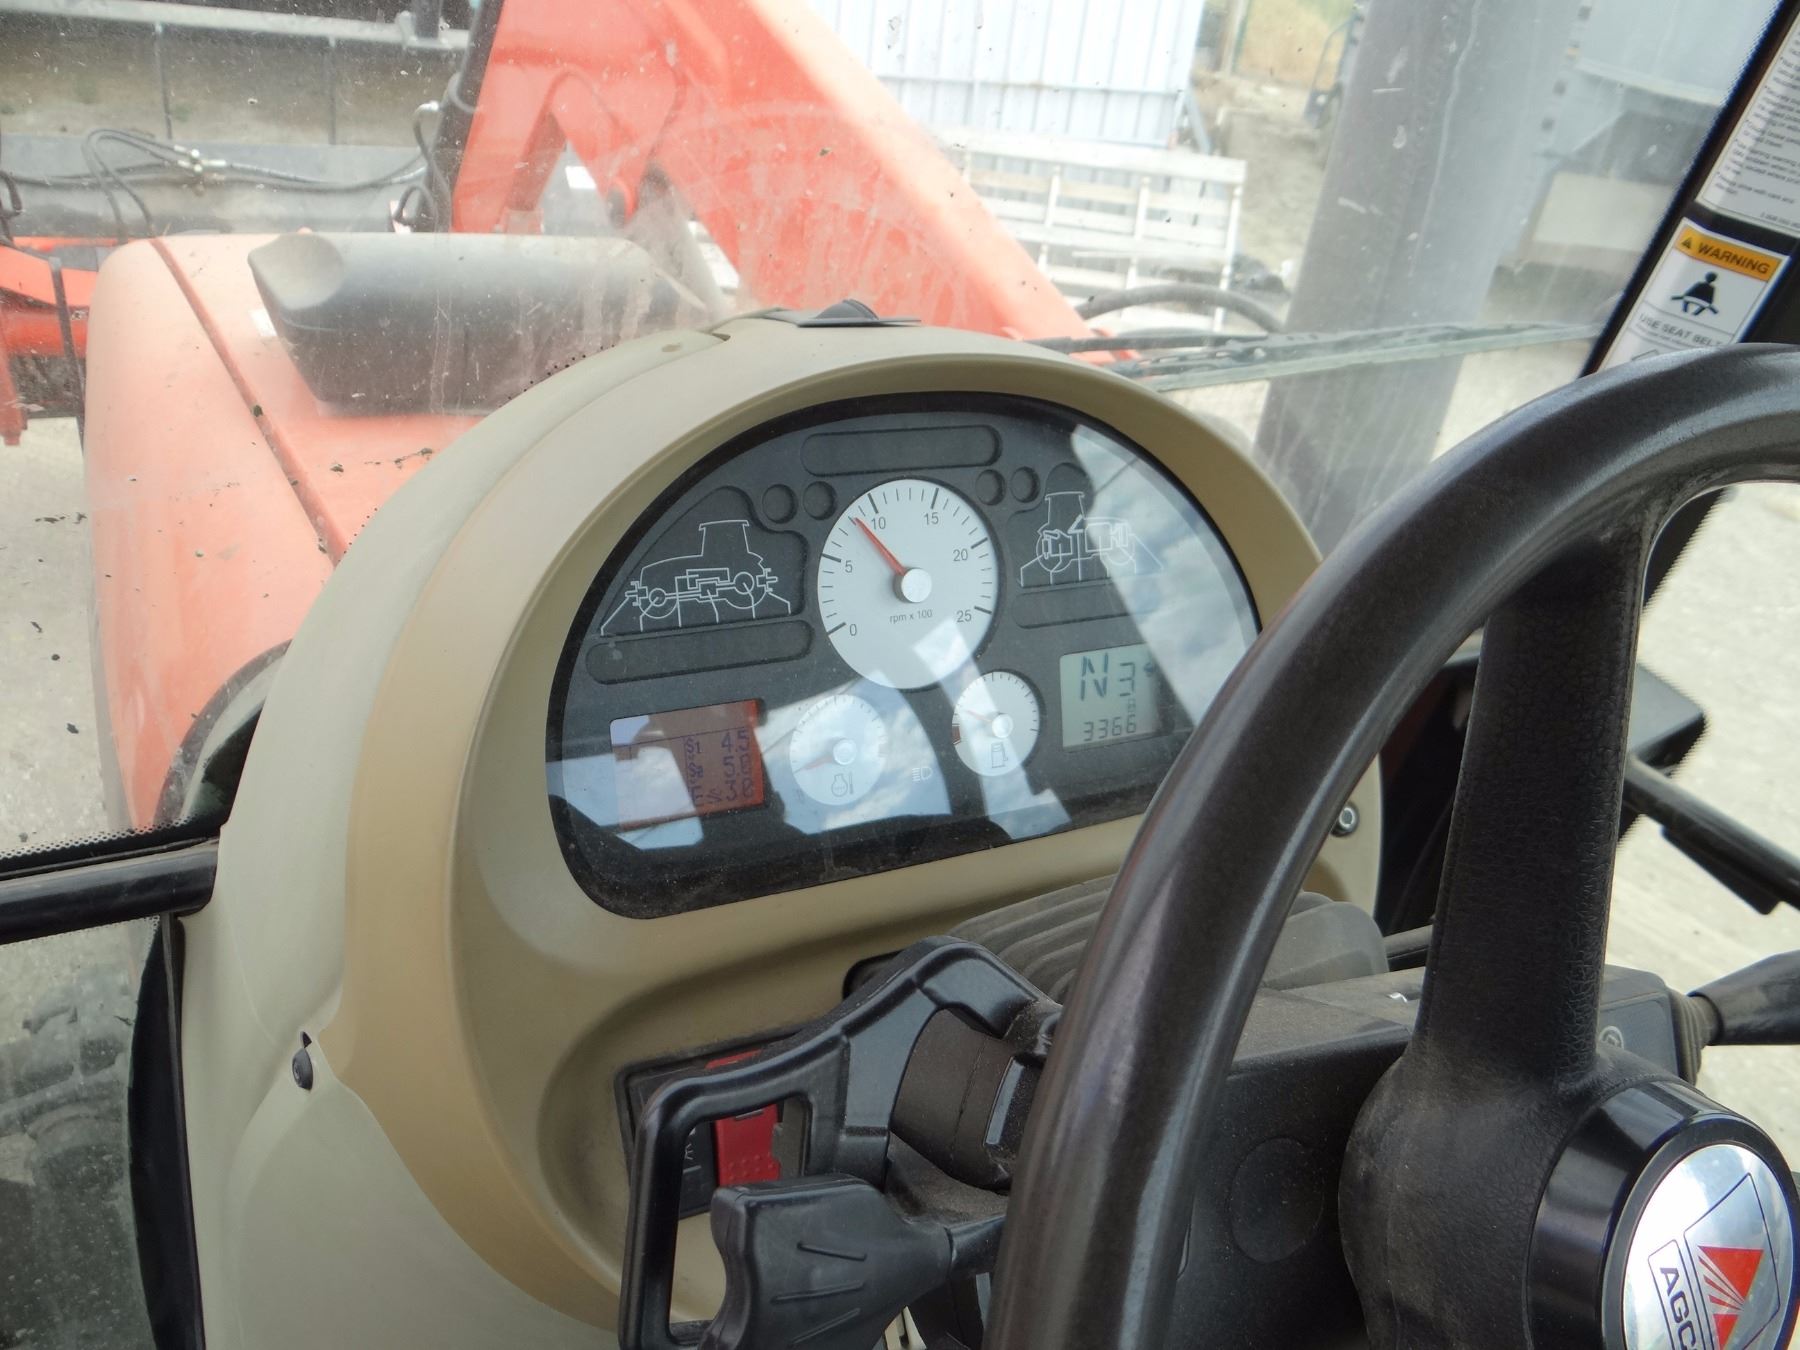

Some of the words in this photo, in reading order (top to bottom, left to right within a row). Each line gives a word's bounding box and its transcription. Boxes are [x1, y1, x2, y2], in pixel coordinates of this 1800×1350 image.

[1698, 242, 1770, 275] WARNING
[1638, 313, 1660, 330] USE
[1661, 321, 1693, 340] SEAT
[871, 516, 887, 531] 10
[924, 511, 939, 526] 15
[953, 548, 969, 562] 20
[844, 559, 853, 574] 5
[889, 614, 907, 624] rpm
[917, 608, 933, 619] 100
[956, 609, 972, 623] 25
[849, 623, 858, 637] 0
[1083, 714, 1137, 742] 3366
[1659, 1267, 1698, 1350] AGC
